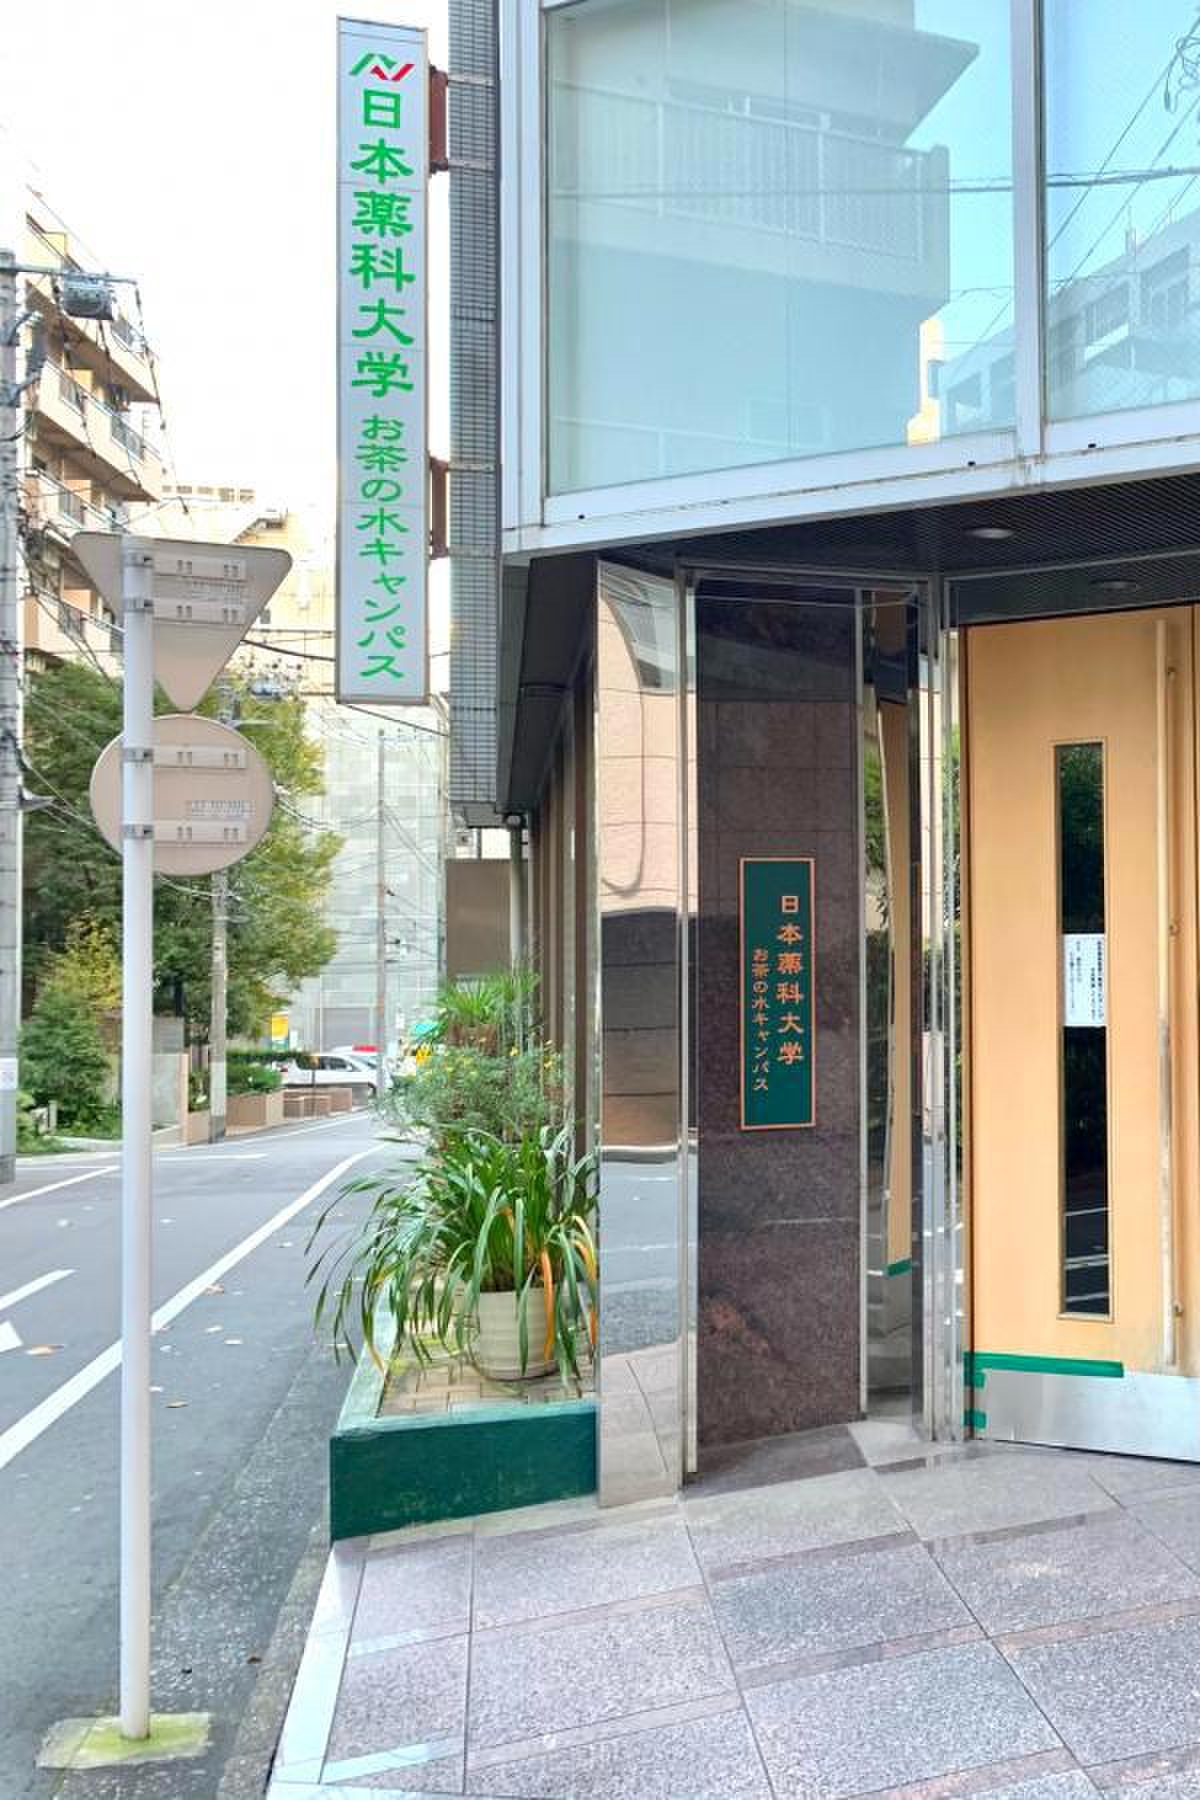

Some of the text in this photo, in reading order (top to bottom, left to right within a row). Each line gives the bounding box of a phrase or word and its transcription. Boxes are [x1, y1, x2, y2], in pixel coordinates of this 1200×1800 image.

[350, 89, 415, 678] 日本薬科大学 お茶の水キャンパス
[751, 948, 769, 1091] お茶の水キャンパス
[776, 895, 804, 1066] 日本薬科大学
